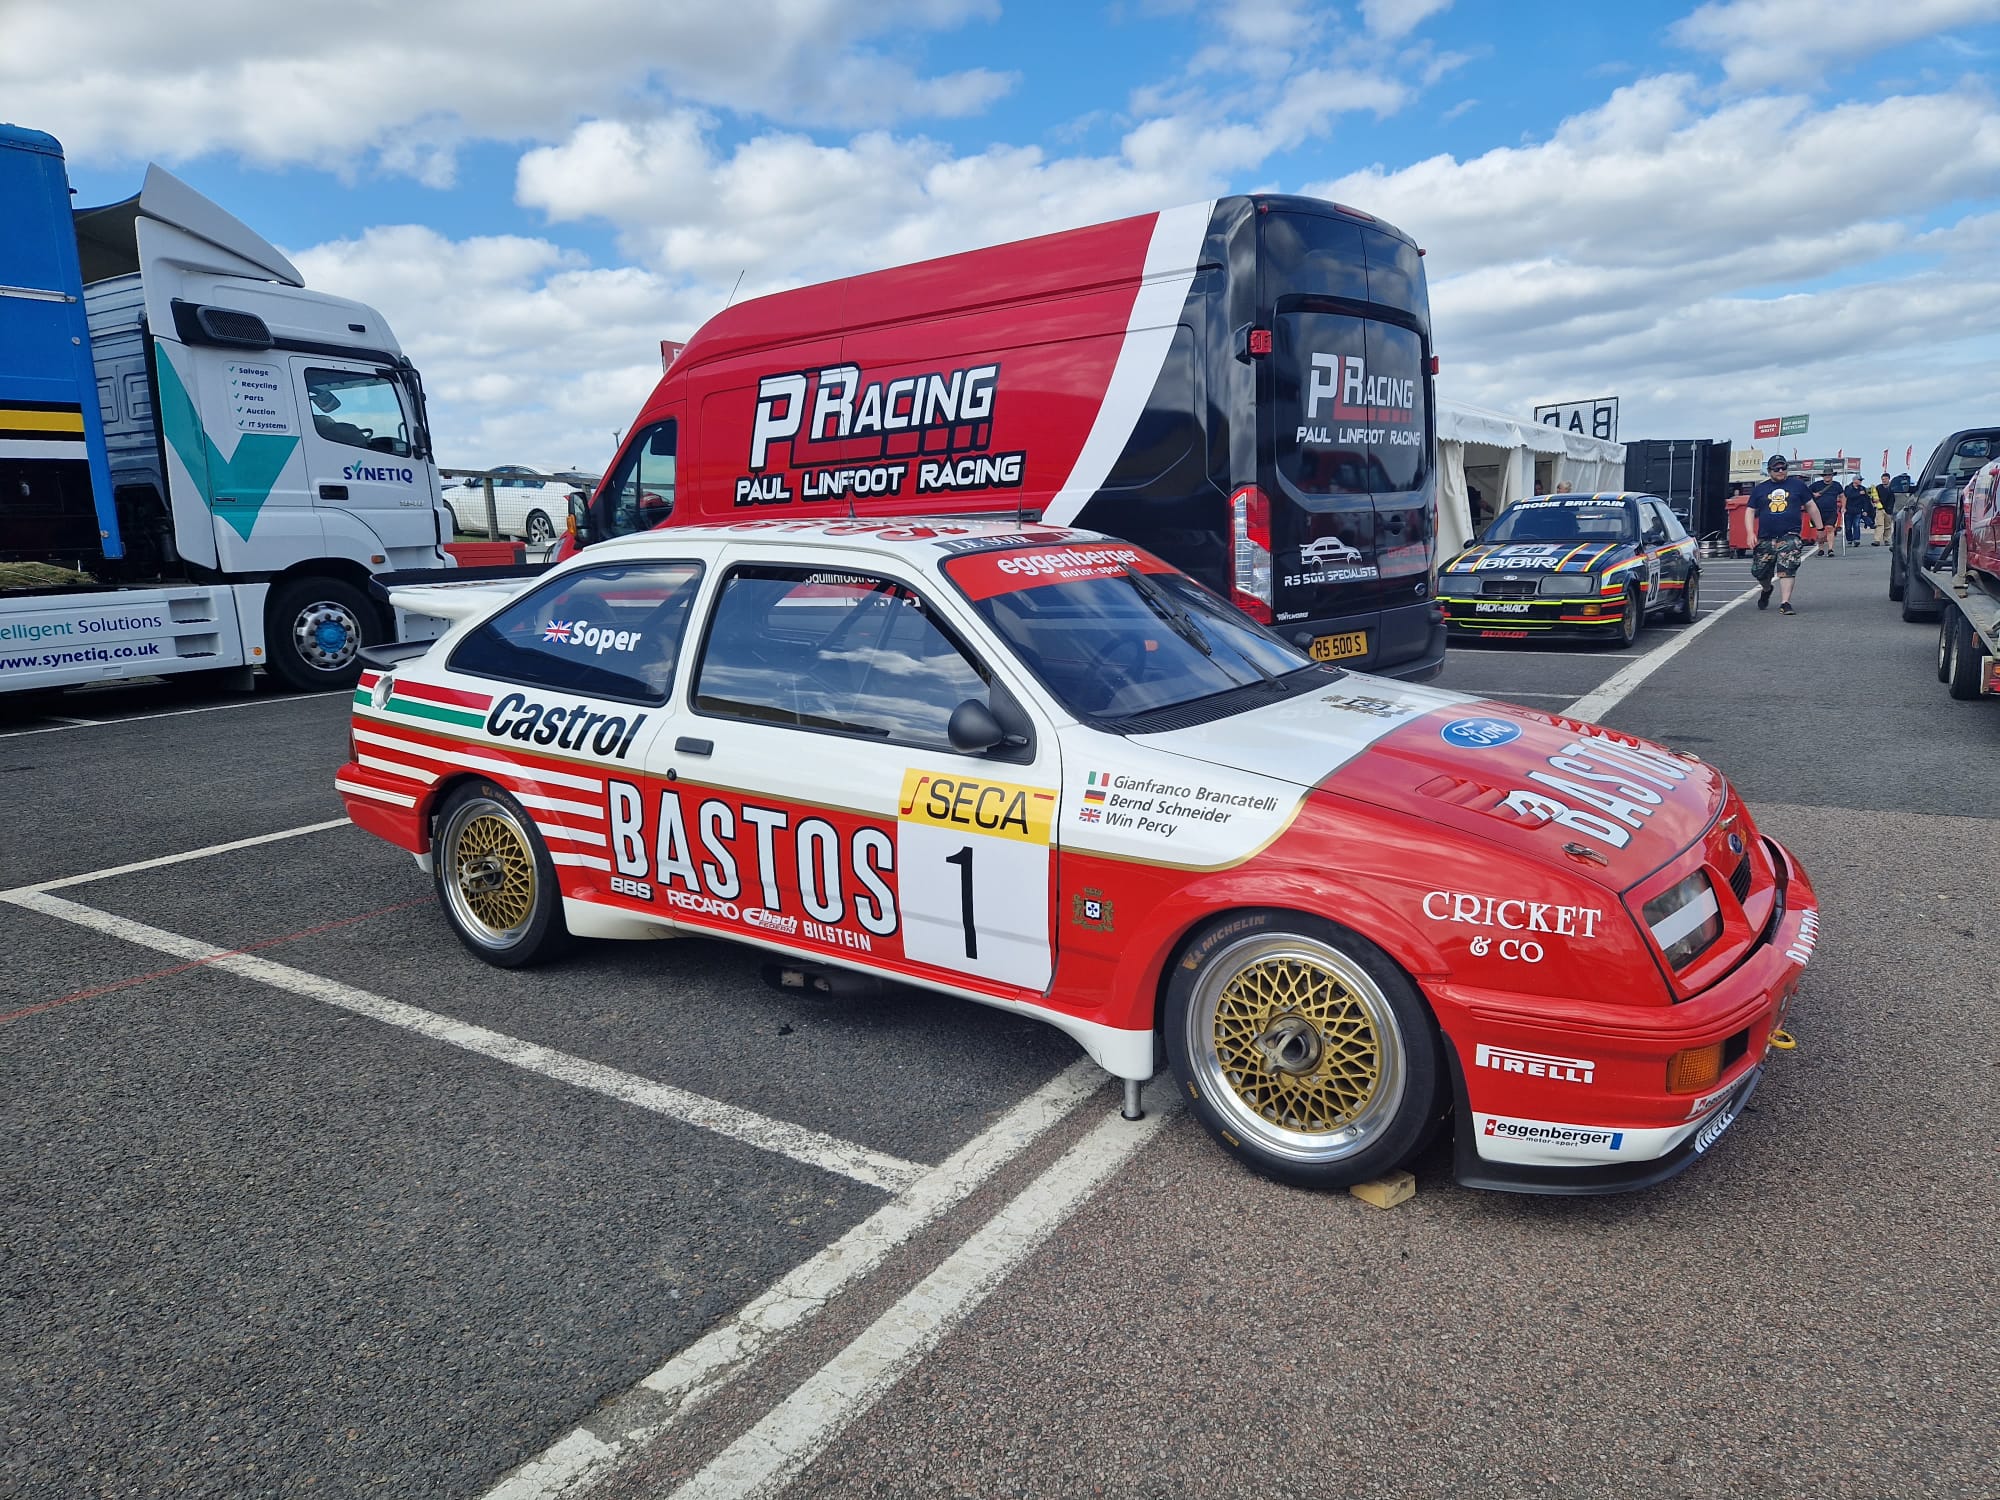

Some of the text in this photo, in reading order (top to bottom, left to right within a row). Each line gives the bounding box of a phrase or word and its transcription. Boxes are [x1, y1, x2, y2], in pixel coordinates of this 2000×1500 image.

[239, 367, 269, 377] Salvage
[241, 381, 278, 391] Recycling
[244, 394, 264, 402] Parts
[246, 408, 276, 416] Auction
[257, 422, 287, 430] Systems
[1296, 426, 1420, 446] PAUL LINFOOT RACING
[343, 459, 413, 484] SYNETIQ
[1737, 458, 1760, 466] COFFEE
[735, 455, 1023, 502] PAUL LINFOOT RACING
[1513, 500, 1626, 511] BRODIE BRITTAIN
[948, 533, 1035, 551] LE SOIR
[997, 548, 1142, 577] eggenberger
[1302, 571, 1325, 585] 500
[1327, 566, 1378, 582] SPECIALISTS
[0, 616, 162, 641] elligent Solutions
[570, 620, 642, 654] Soper
[486, 692, 648, 760] Castrol
[1452, 720, 1514, 745] Ford
[1113, 775, 1279, 812] Gianfranco Brancatelli
[926, 778, 1029, 836] SECA
[1109, 793, 1232, 824] Bernd Schneider
[1105, 811, 1178, 838] Win Percy
[608, 778, 899, 938] BASTOS
[610, 876, 653, 900] BBS
[666, 889, 740, 920] RECARO
[945, 845, 978, 960] 1
[1422, 891, 1602, 938] CRICKET
[742, 907, 798, 929] Eibach
[803, 920, 872, 952] BILSTEIN
[1201, 915, 1266, 952] MICHELIN
[1469, 936, 1544, 963] & CO
[1475, 1043, 1596, 1084] PIRELLI
[1497, 1122, 1611, 1145] eggenberger
[1525, 1137, 1579, 1147] motor-sport
